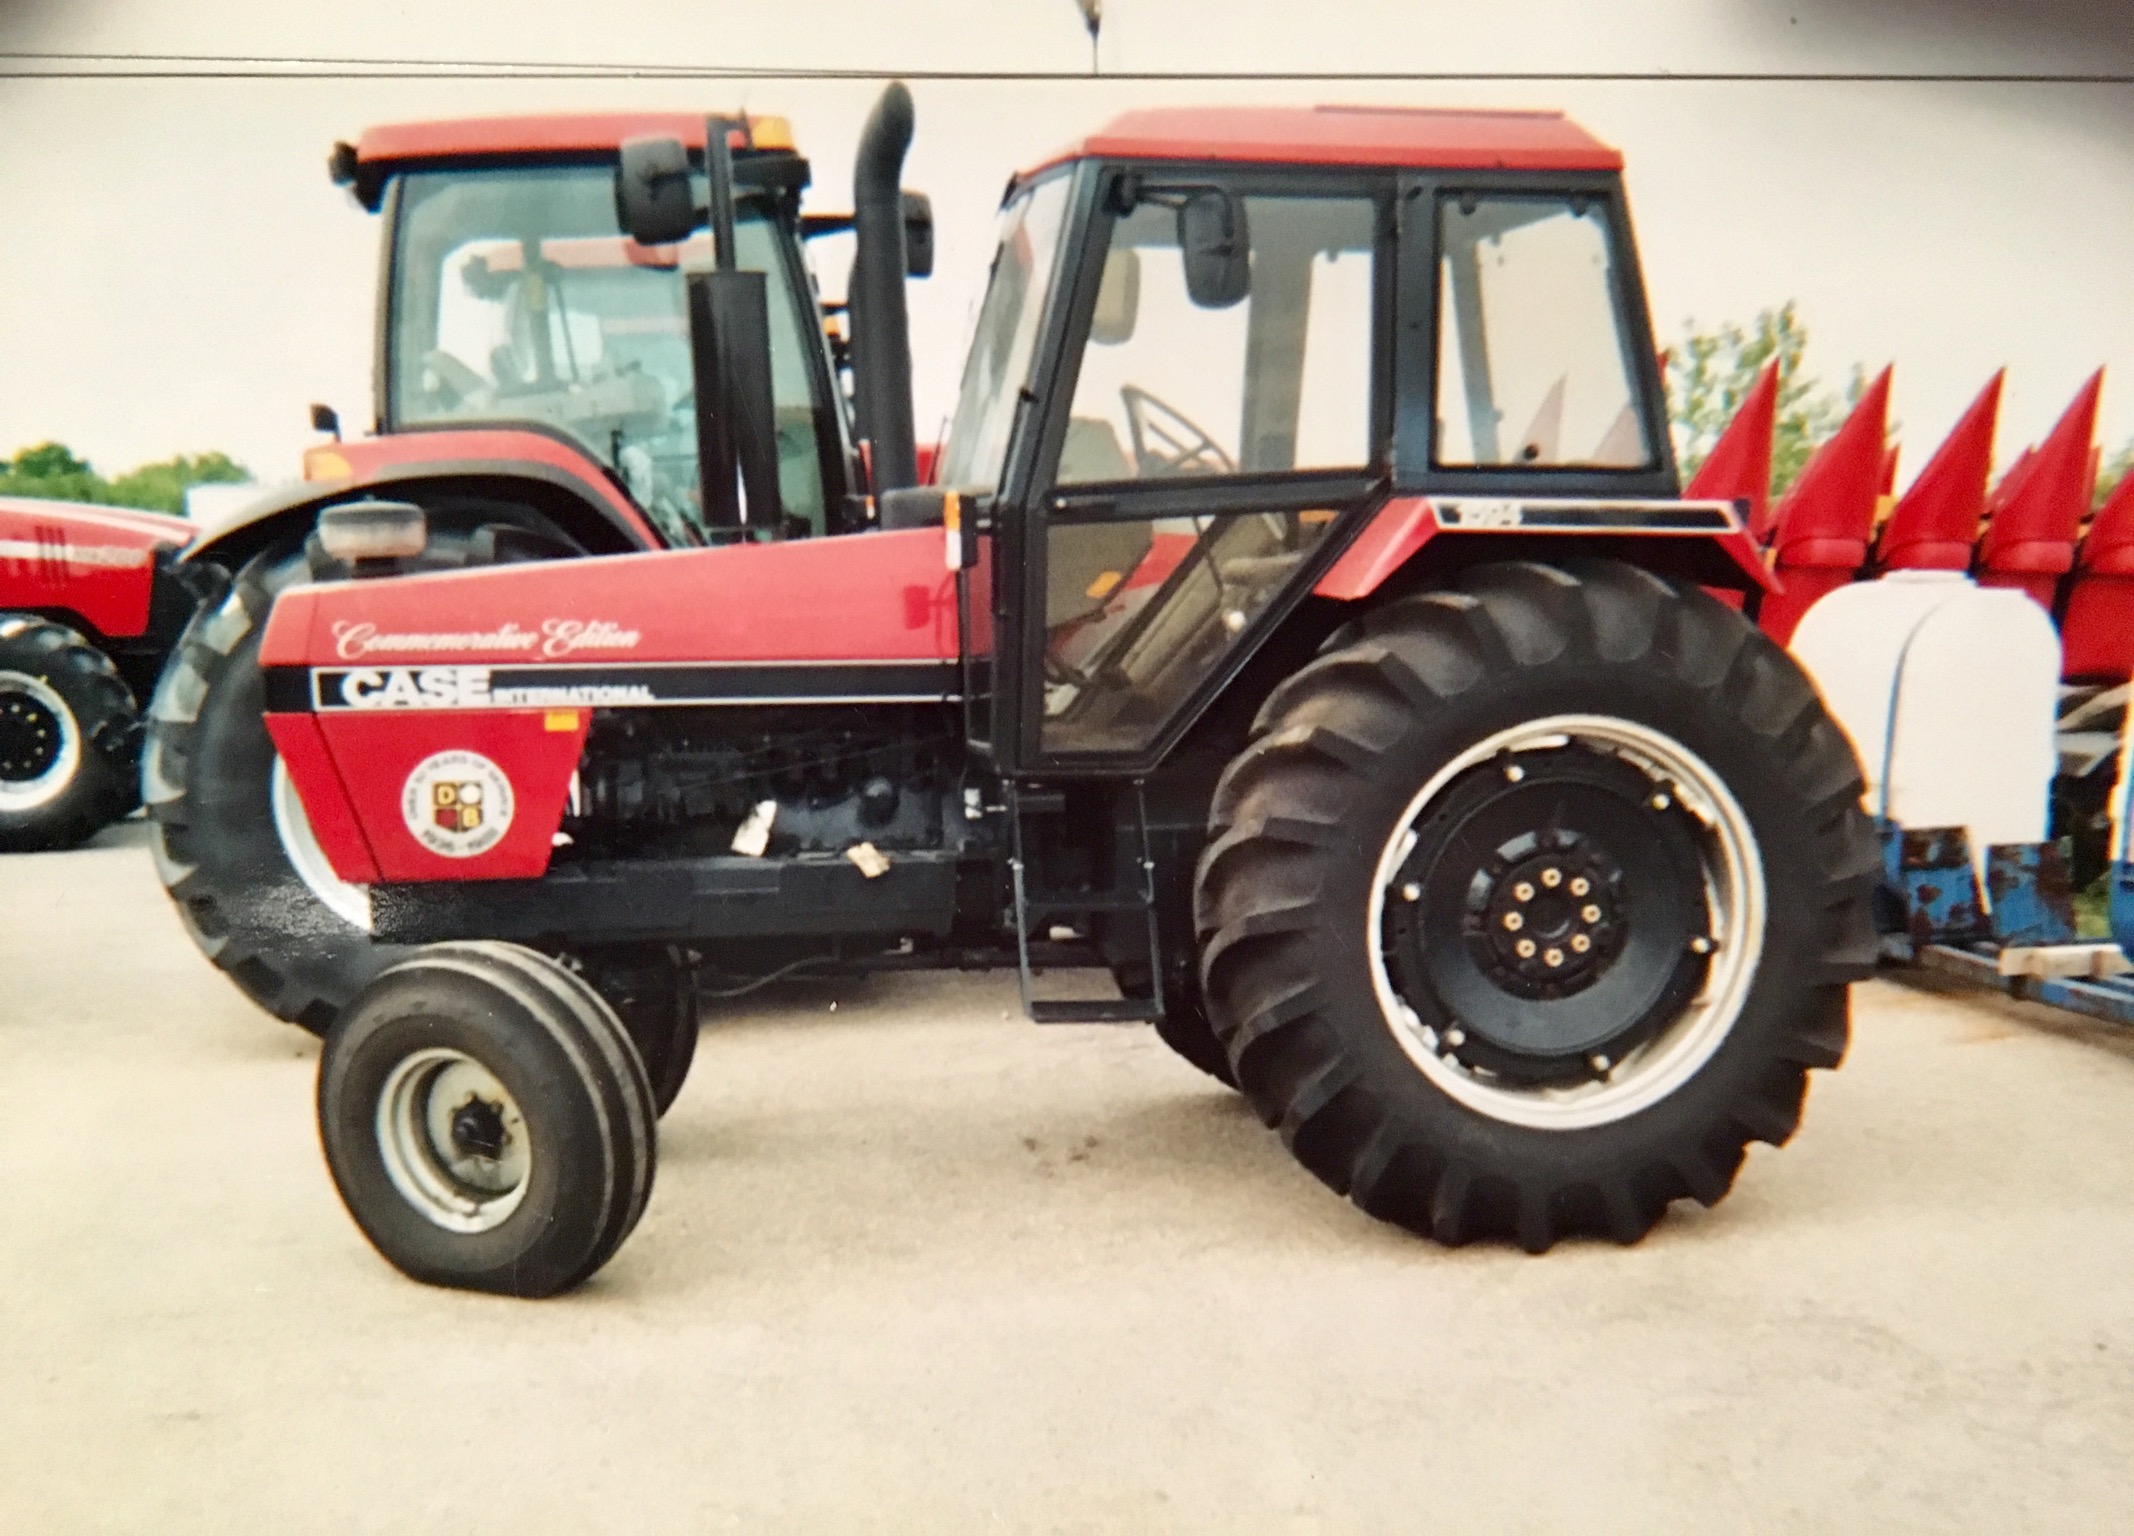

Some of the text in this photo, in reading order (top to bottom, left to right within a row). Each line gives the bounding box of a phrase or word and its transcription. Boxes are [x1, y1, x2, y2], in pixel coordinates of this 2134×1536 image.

[331, 618, 642, 660] Commemorative Edition
[341, 668, 490, 707] CASE
[492, 685, 656, 706] INTERNATIONAL
